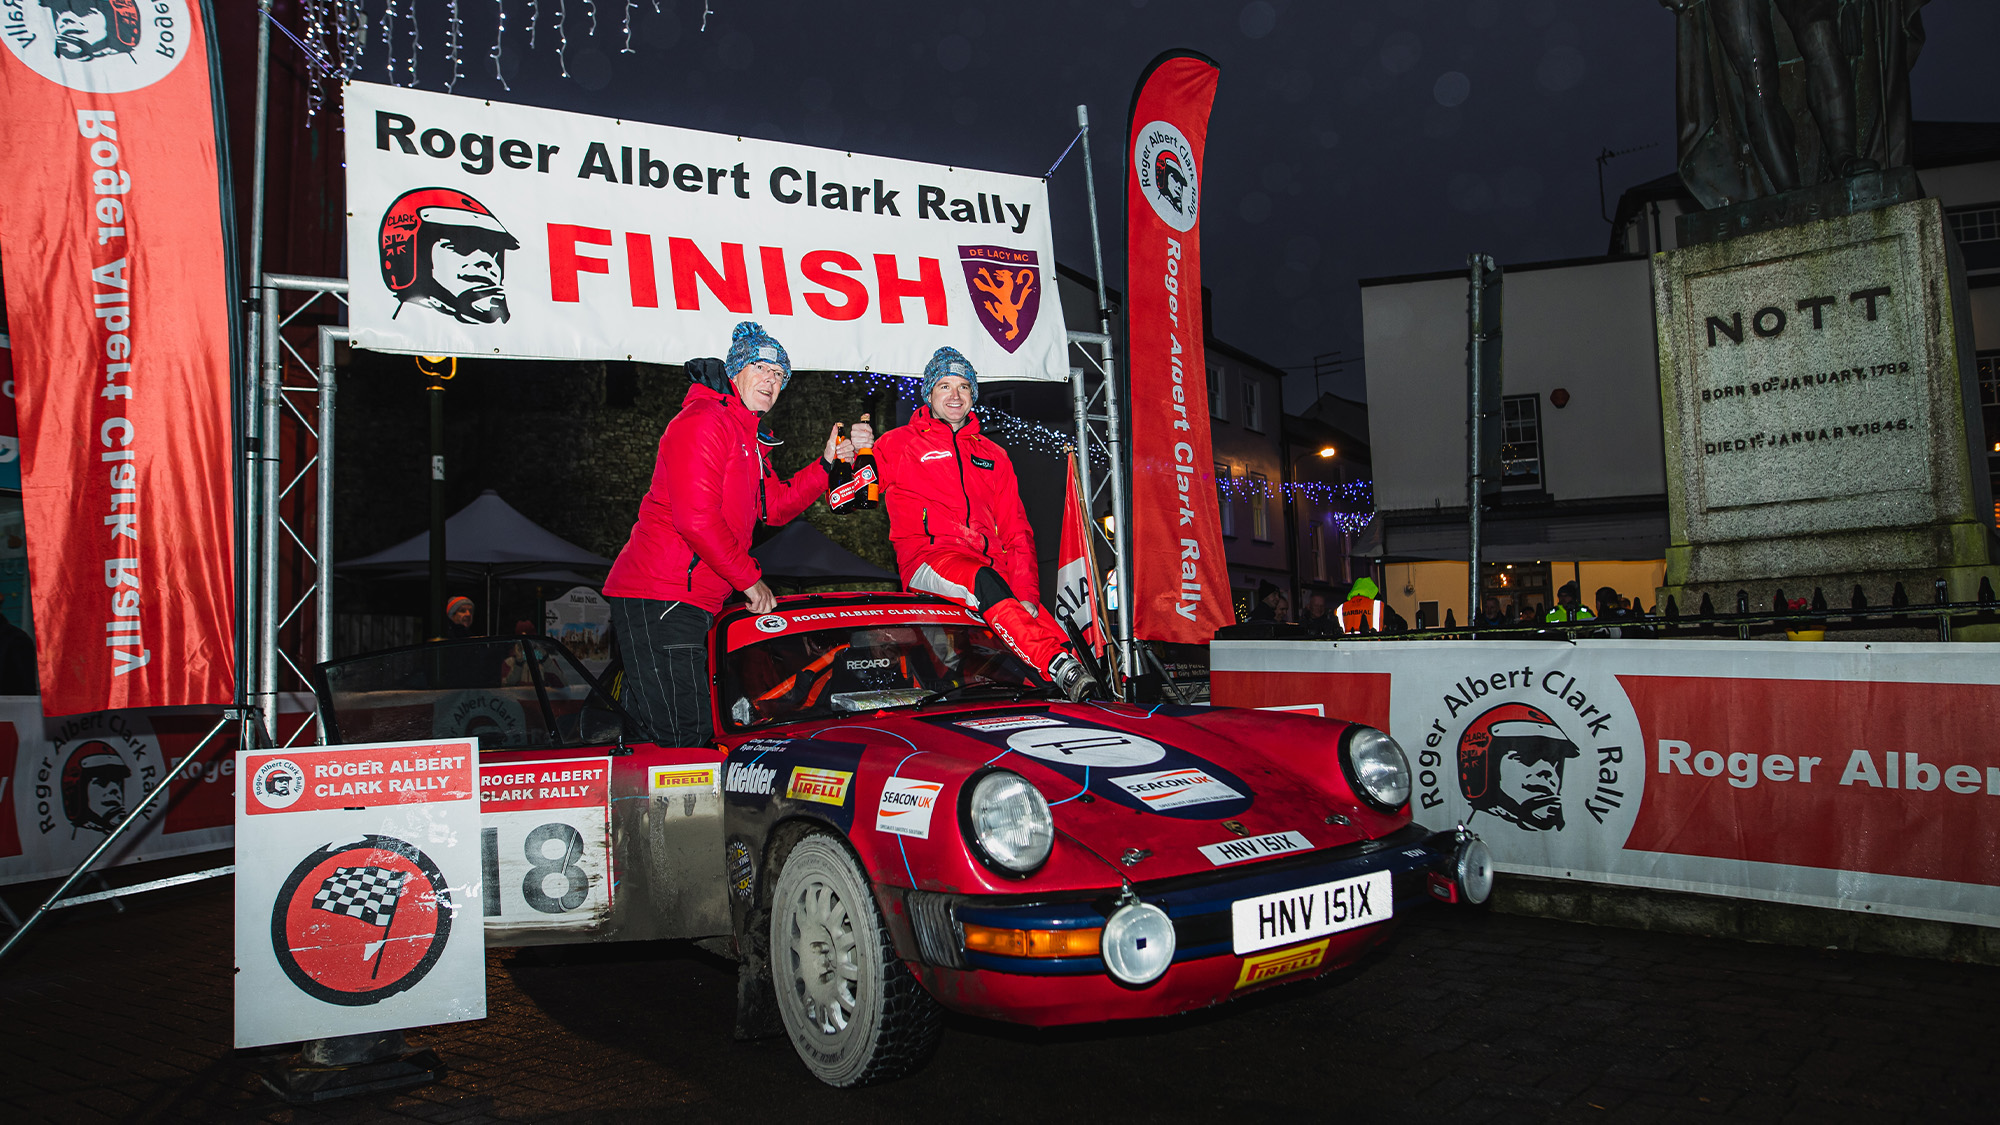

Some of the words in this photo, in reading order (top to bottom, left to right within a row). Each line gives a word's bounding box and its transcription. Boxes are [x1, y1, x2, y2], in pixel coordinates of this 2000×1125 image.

[375, 109, 561, 175] Roger
[577, 141, 750, 199] Albert
[769, 166, 901, 217] Clark
[918, 184, 1031, 234] Rally
[1141, 145, 1152, 188] Roger
[1148, 131, 1178, 149] Albert
[1179, 145, 1195, 182] Clark
[387, 213, 415, 227] CLARK
[969, 248, 984, 257] DE
[987, 249, 1011, 260] LACY
[1013, 253, 1029, 262] MC
[547, 222, 949, 327] FINISH
[1164, 236, 1182, 329] Roger
[1706, 286, 1891, 347] NOTT
[1170, 333, 1192, 432] Albert
[1701, 385, 1746, 402] BORN
[1704, 438, 1746, 455] DIED
[1174, 445, 1195, 527] Clark
[1175, 538, 1201, 622] Rally
[791, 611, 837, 623] ROGER
[839, 609, 885, 618] ALBERT
[887, 608, 927, 616] CLARK
[928, 608, 961, 617] RALLY
[846, 657, 890, 671] RECARO
[1418, 718, 1447, 810] Roger
[1443, 666, 1534, 719] Albert
[1541, 670, 1612, 738] Clark
[1585, 745, 1624, 825] Rally
[1463, 731, 1487, 744] CLARK
[35, 757, 56, 835] Roger
[52, 711, 103, 755] Albert
[108, 714, 147, 761] Clark
[255, 774, 263, 796] Roger
[260, 761, 282, 775] Albert
[283, 761, 300, 776] Clark
[314, 761, 385, 779] ROGER
[388, 755, 466, 773] ALBERT
[480, 772, 536, 787] ROGER
[540, 768, 604, 783] ALBERT
[659, 771, 710, 786] PIRELLI
[1657, 738, 1823, 789] Roger
[314, 779, 384, 798] CLARK
[388, 774, 451, 793] RALLY
[480, 787, 534, 802] CLARK
[539, 784, 590, 799] RALLY
[791, 772, 845, 798] PIRELLI
[1216, 840, 1262, 860] HNV
[1262, 833, 1298, 852] 151X
[480, 822, 589, 917] 18
[1258, 894, 1314, 940] HNV
[1324, 881, 1373, 926] 151X
[1245, 947, 1322, 983] PIRELLI
